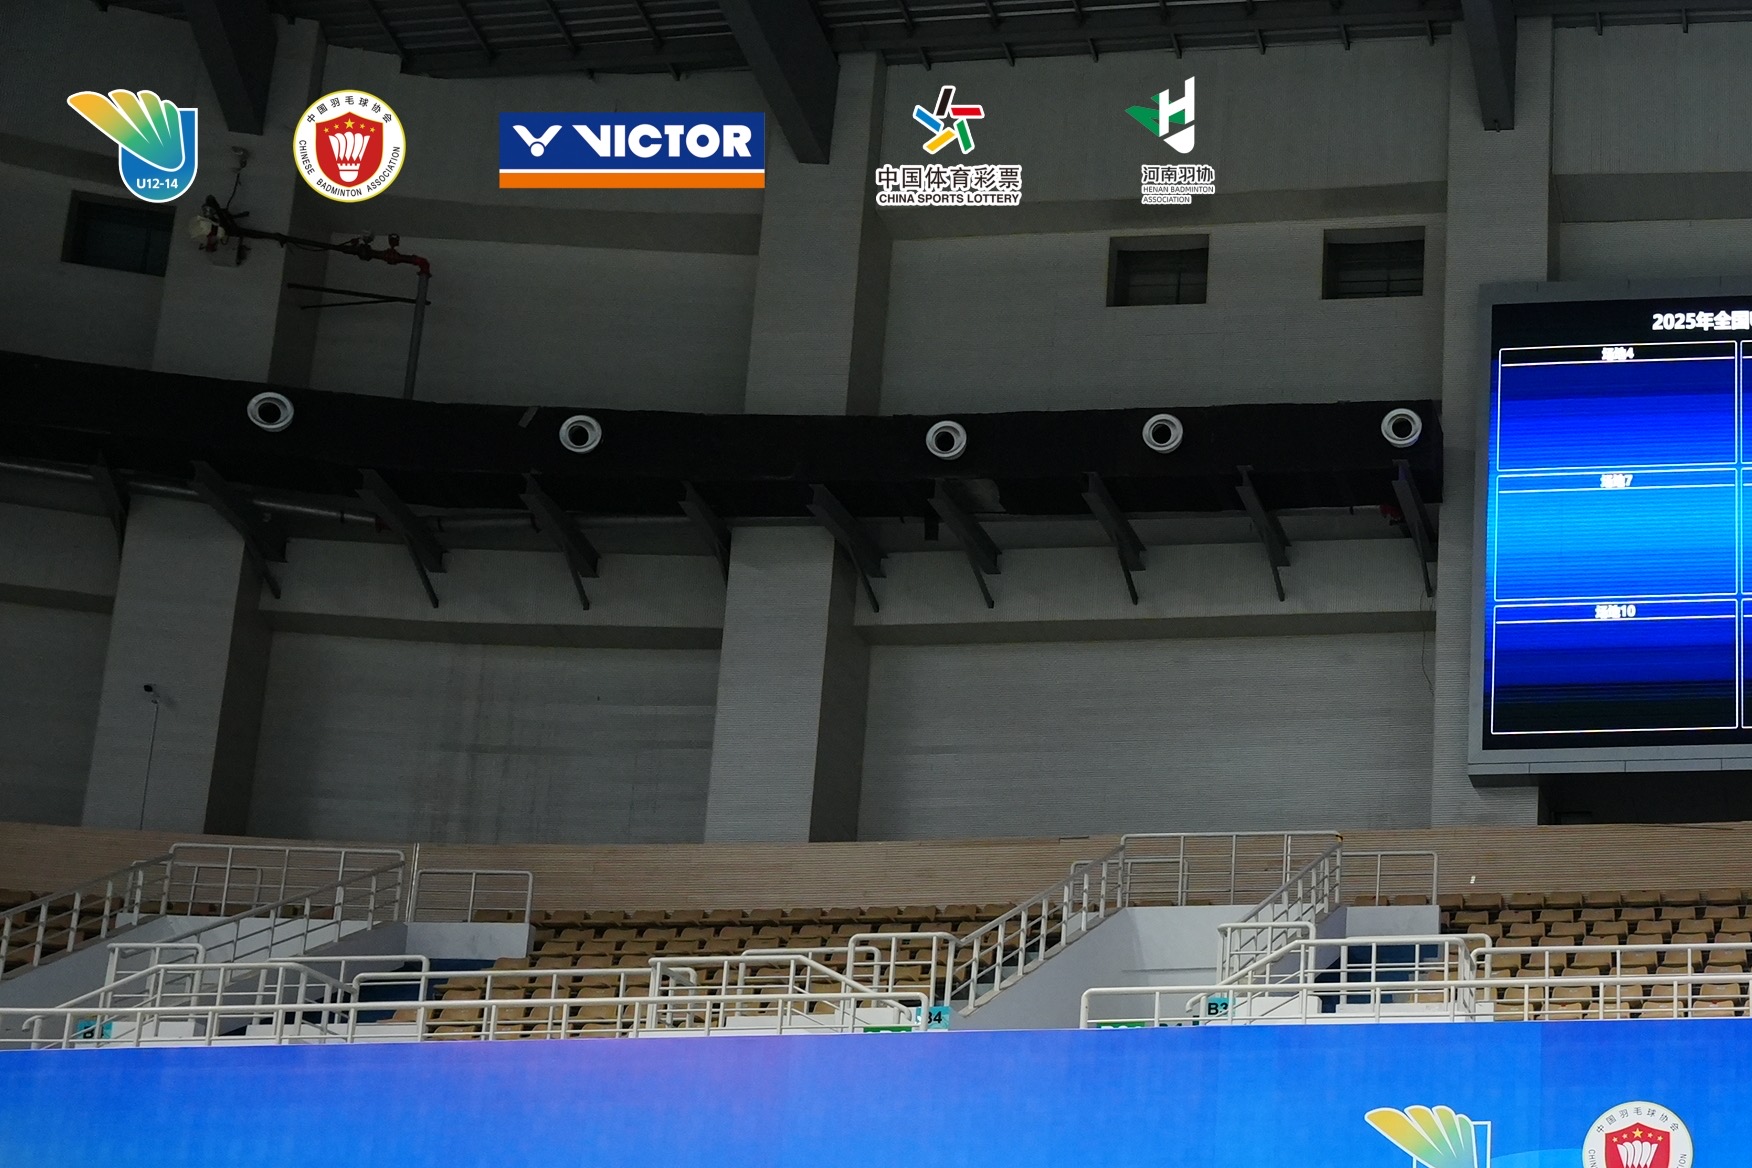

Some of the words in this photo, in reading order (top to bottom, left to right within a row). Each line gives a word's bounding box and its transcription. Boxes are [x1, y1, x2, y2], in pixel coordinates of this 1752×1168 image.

[1596, 1106, 1679, 1133] 中国羽毛球协会
